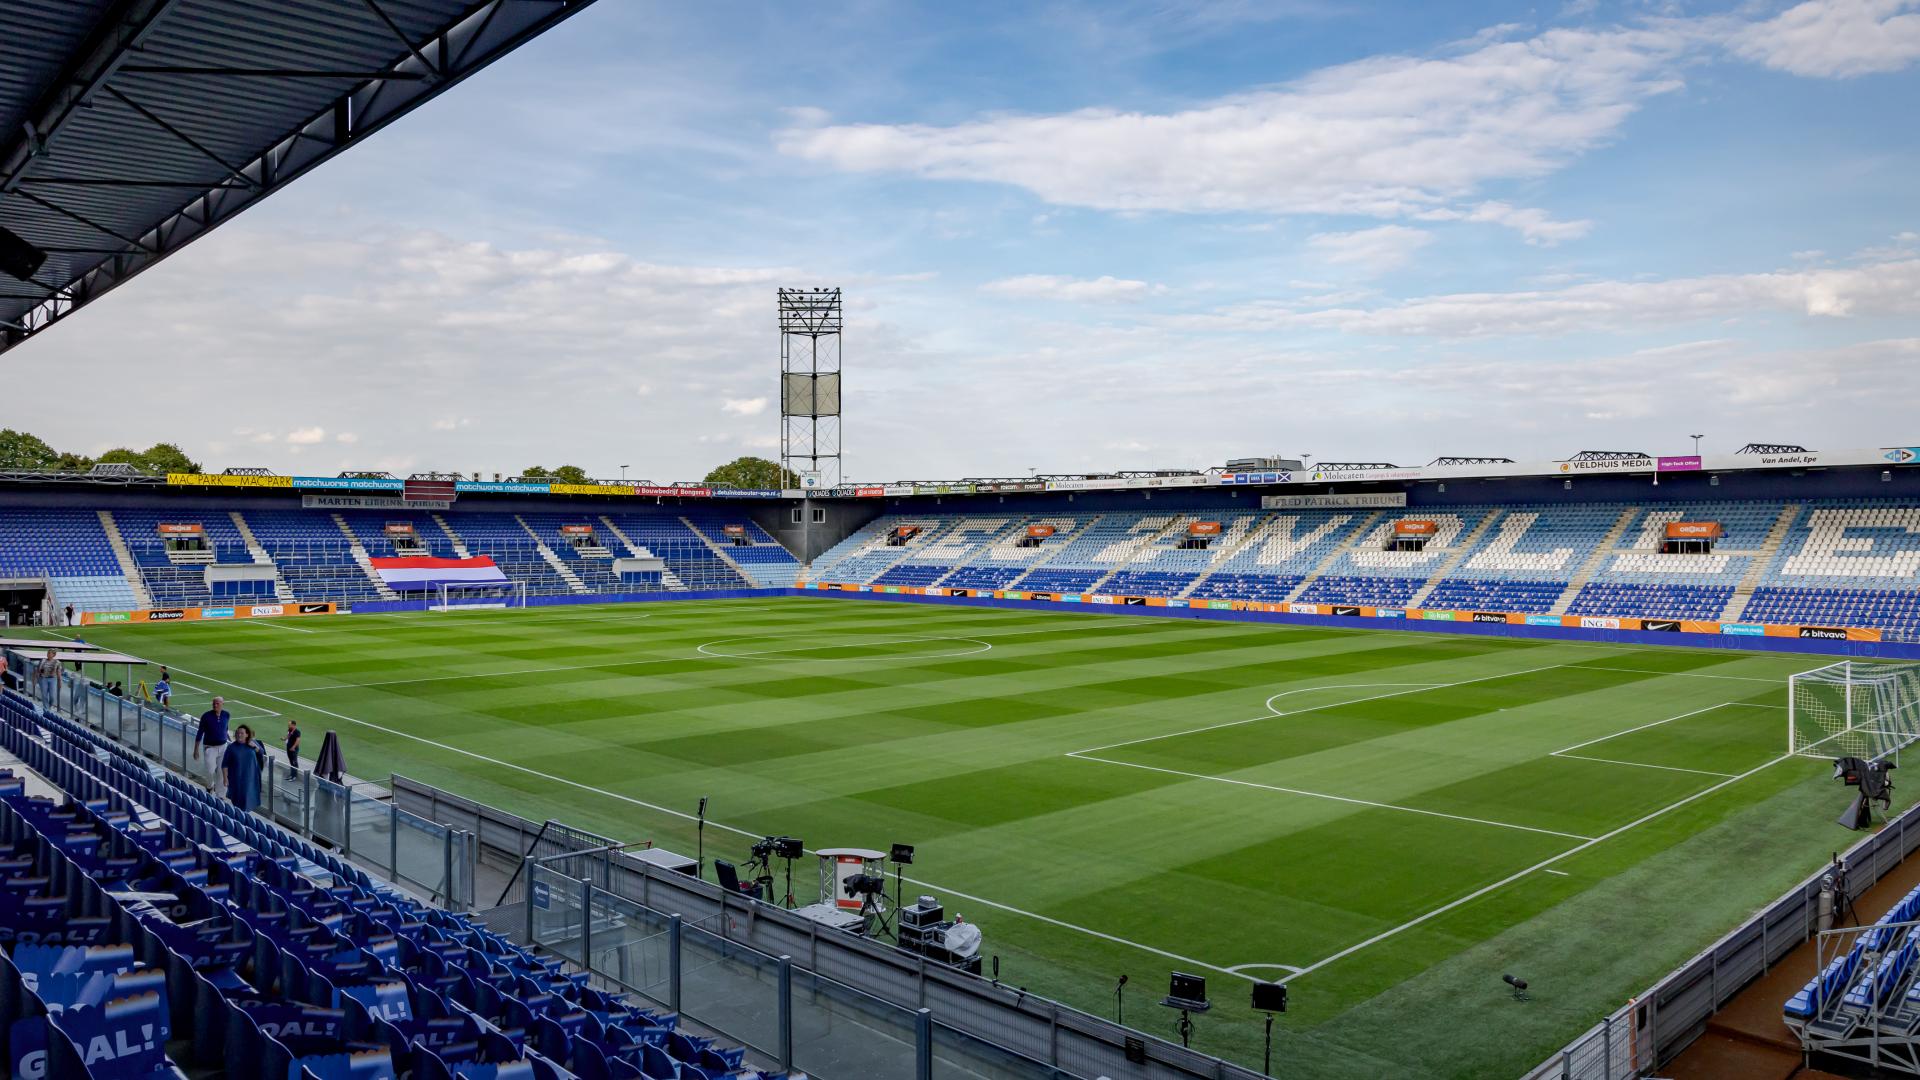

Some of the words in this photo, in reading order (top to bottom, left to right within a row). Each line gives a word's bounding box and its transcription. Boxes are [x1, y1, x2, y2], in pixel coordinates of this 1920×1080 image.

[1573, 460, 1619, 469] VELDHUIS
[1621, 459, 1652, 468] MEDIA
[1778, 456, 1802, 464] Andel,
[1803, 456, 1817, 464] Epe
[1323, 471, 1365, 481] Molecaten
[293, 479, 349, 488] matchworks
[350, 480, 402, 489] matchworks
[456, 483, 503, 491] matchworks
[504, 484, 550, 492] matchworks
[641, 487, 679, 496] Bouwbedrijf
[680, 488, 704, 496] Bongers
[318, 498, 361, 506] MARTEN
[1275, 497, 1301, 506] FRED
[1304, 496, 1350, 506] PATRICK
[1355, 495, 1403, 505] TRIBUNE
[158, 610, 184, 619] bitvavo
[253, 608, 271, 616] ING
[1481, 615, 1506, 623] bitvavo
[1583, 619, 1603, 628] ING
[1811, 629, 1846, 639] bitvavo
[258, 1021, 336, 1038] OAL!
